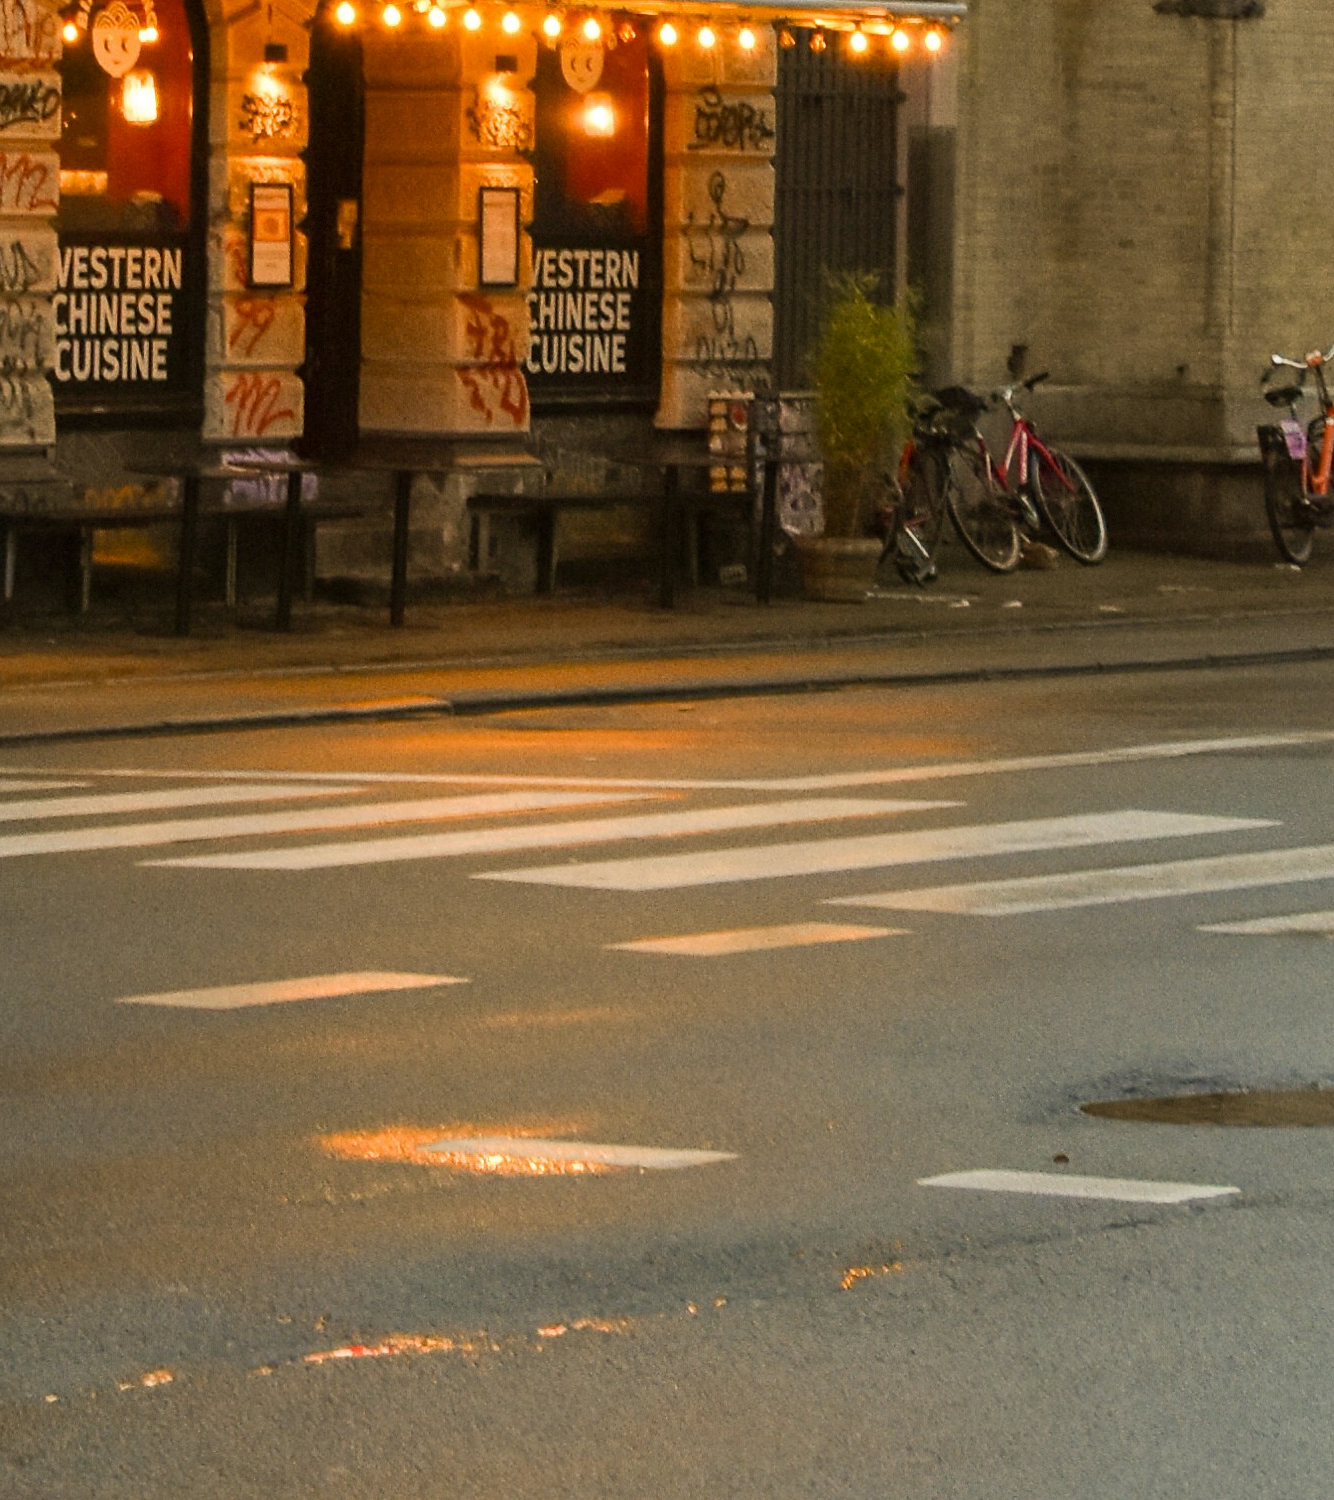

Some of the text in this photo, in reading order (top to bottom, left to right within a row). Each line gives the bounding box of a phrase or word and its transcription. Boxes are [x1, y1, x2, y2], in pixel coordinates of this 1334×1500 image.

[532, 249, 640, 289] ESTERN
[51, 291, 173, 336] CHINESE
[525, 291, 632, 331] CHINESE
[53, 337, 168, 382] CUISINE
[525, 333, 627, 375] CUISINE
